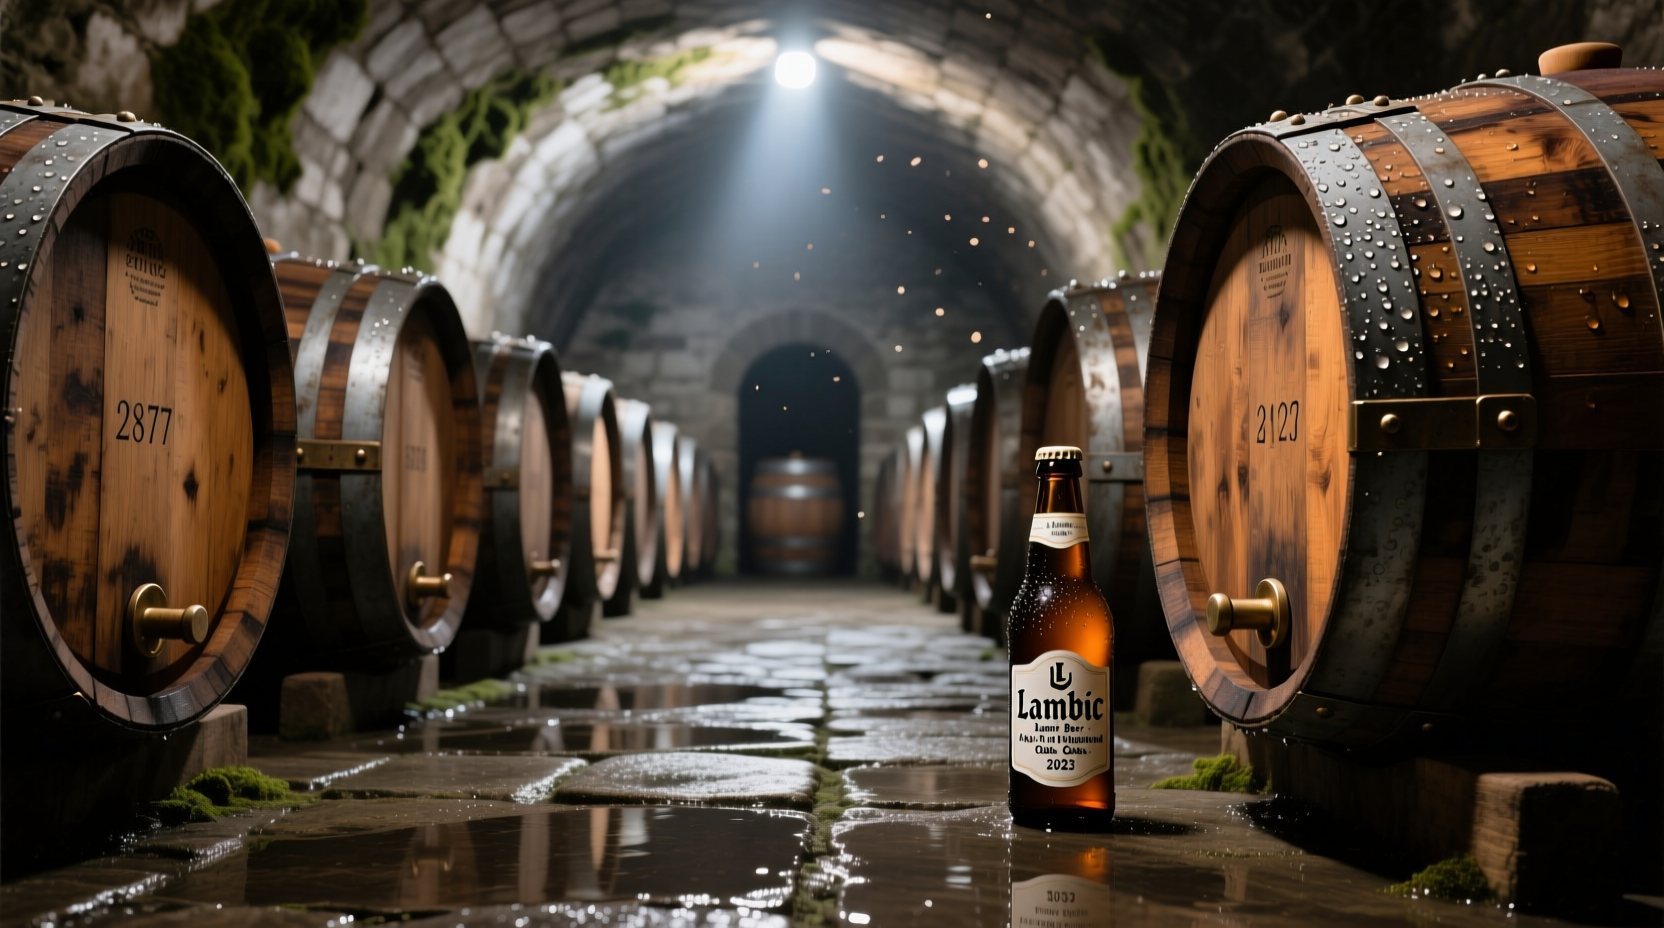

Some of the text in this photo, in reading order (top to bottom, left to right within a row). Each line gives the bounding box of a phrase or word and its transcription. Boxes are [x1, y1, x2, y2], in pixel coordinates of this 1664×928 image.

[116, 400, 172, 445] 2877
[1018, 689, 1104, 720] Lambic
[1046, 759, 1075, 770] 2023
